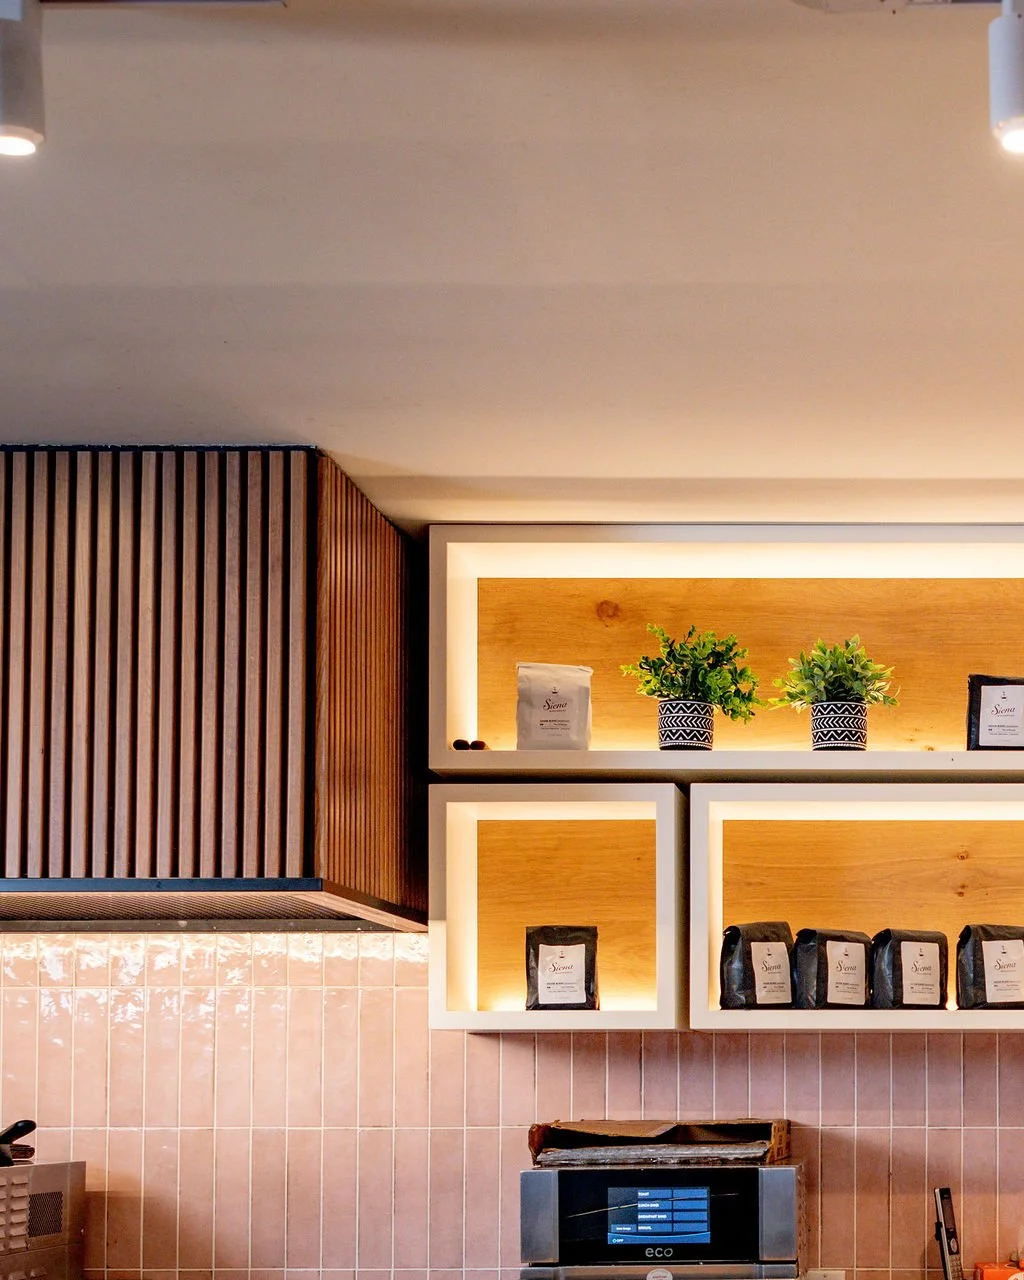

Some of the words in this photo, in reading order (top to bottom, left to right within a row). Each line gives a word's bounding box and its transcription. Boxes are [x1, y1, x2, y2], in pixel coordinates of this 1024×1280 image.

[543, 698, 568, 711] Siena
[991, 703, 1016, 715] Siena
[645, 1247, 674, 1257] eco
